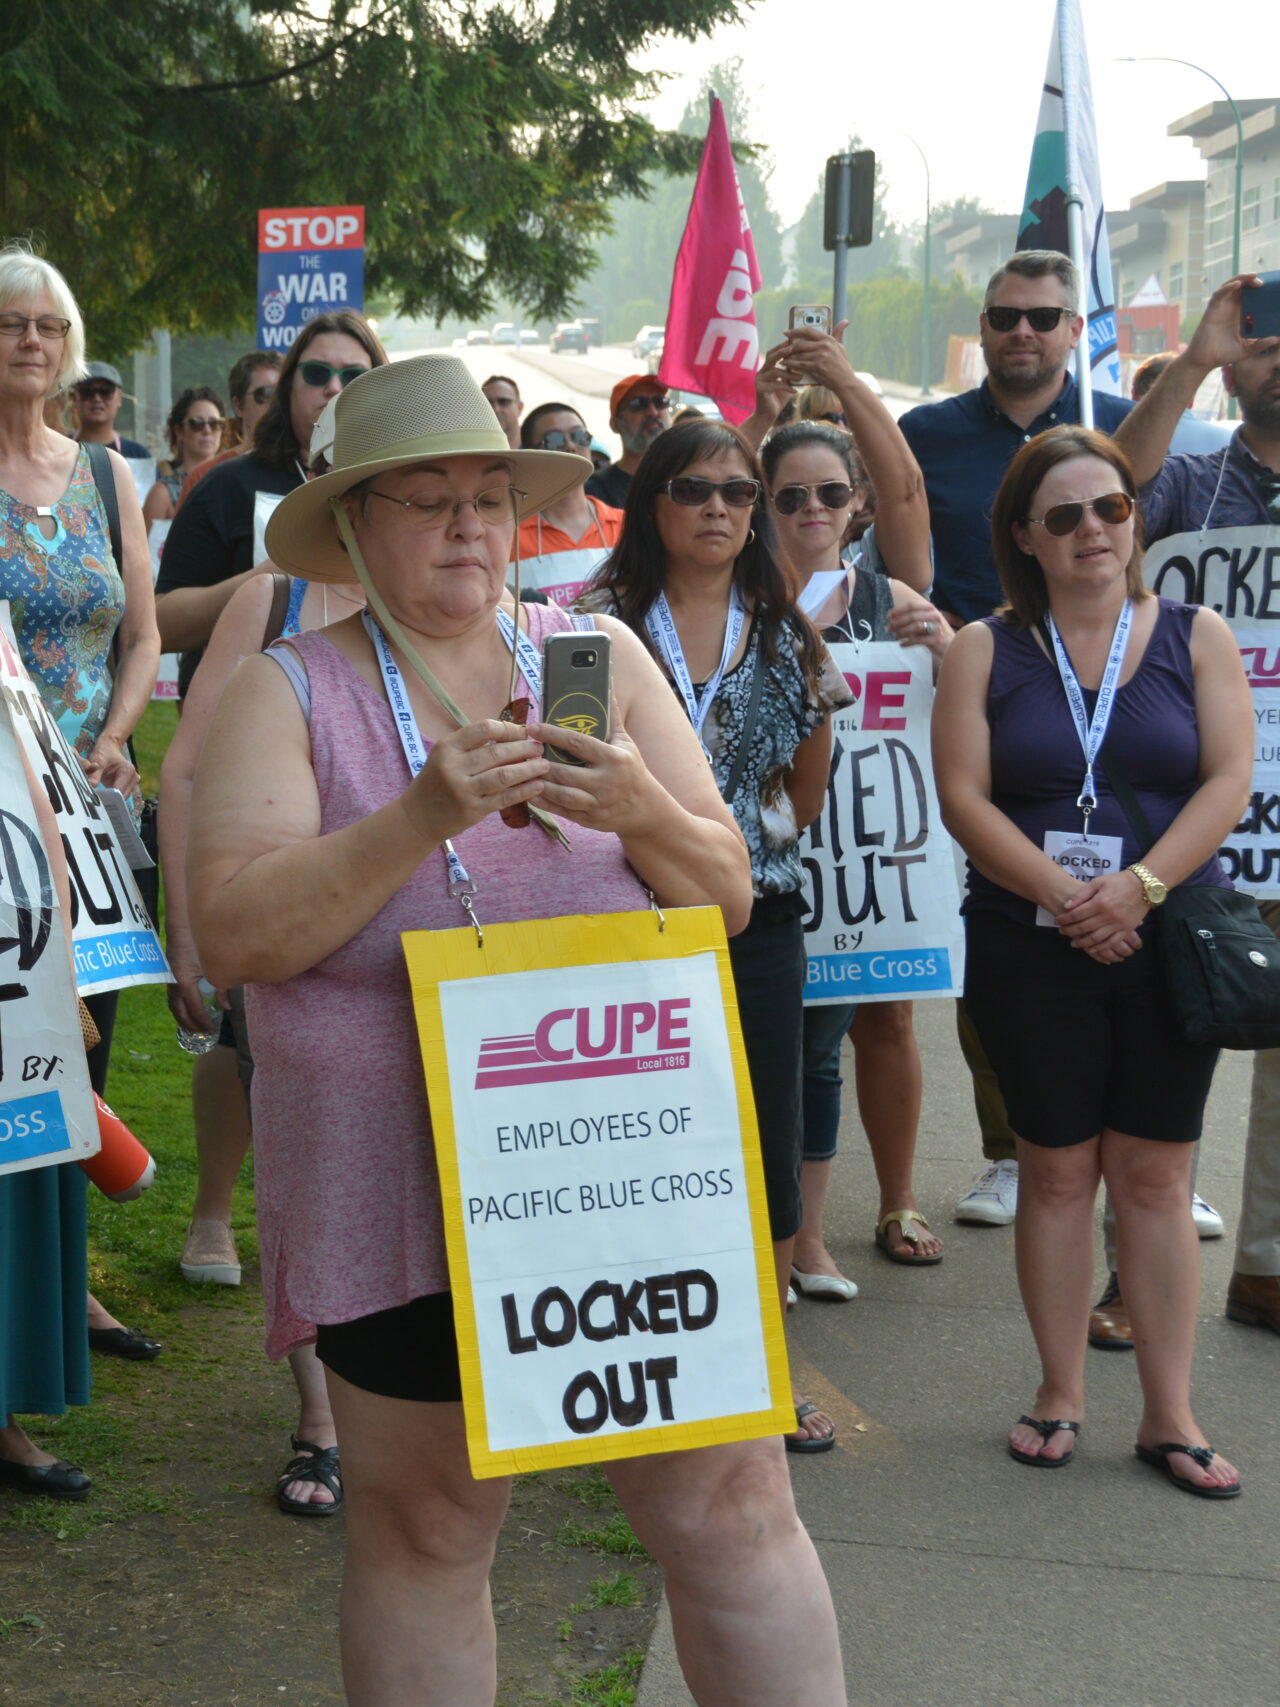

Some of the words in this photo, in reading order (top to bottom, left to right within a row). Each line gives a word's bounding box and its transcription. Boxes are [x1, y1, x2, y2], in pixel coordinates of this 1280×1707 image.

[265, 216, 359, 248] STOP
[299, 255, 321, 269] THE
[278, 272, 348, 304] WAR
[1094, 686, 1112, 724] CUPEBC
[402, 723, 415, 743] CUPE
[833, 719, 858, 732] 1816
[96, 937, 136, 968] Blue
[131, 935, 160, 962] Cross
[834, 930, 863, 951] BY
[806, 962, 862, 984] Blue
[869, 955, 937, 978] Cross
[535, 997, 691, 1063] CUPE
[637, 1057, 662, 1071] Local
[664, 1054, 686, 1068] 1816
[496, 1111, 652, 1153] EMPLOYEES
[658, 1106, 693, 1135] OF
[468, 1187, 572, 1225] PACIFIC
[579, 1178, 644, 1212] BLUE
[651, 1168, 734, 1203] CROSS
[501, 1268, 719, 1355] LOCKED
[562, 1355, 678, 1434] OUT
